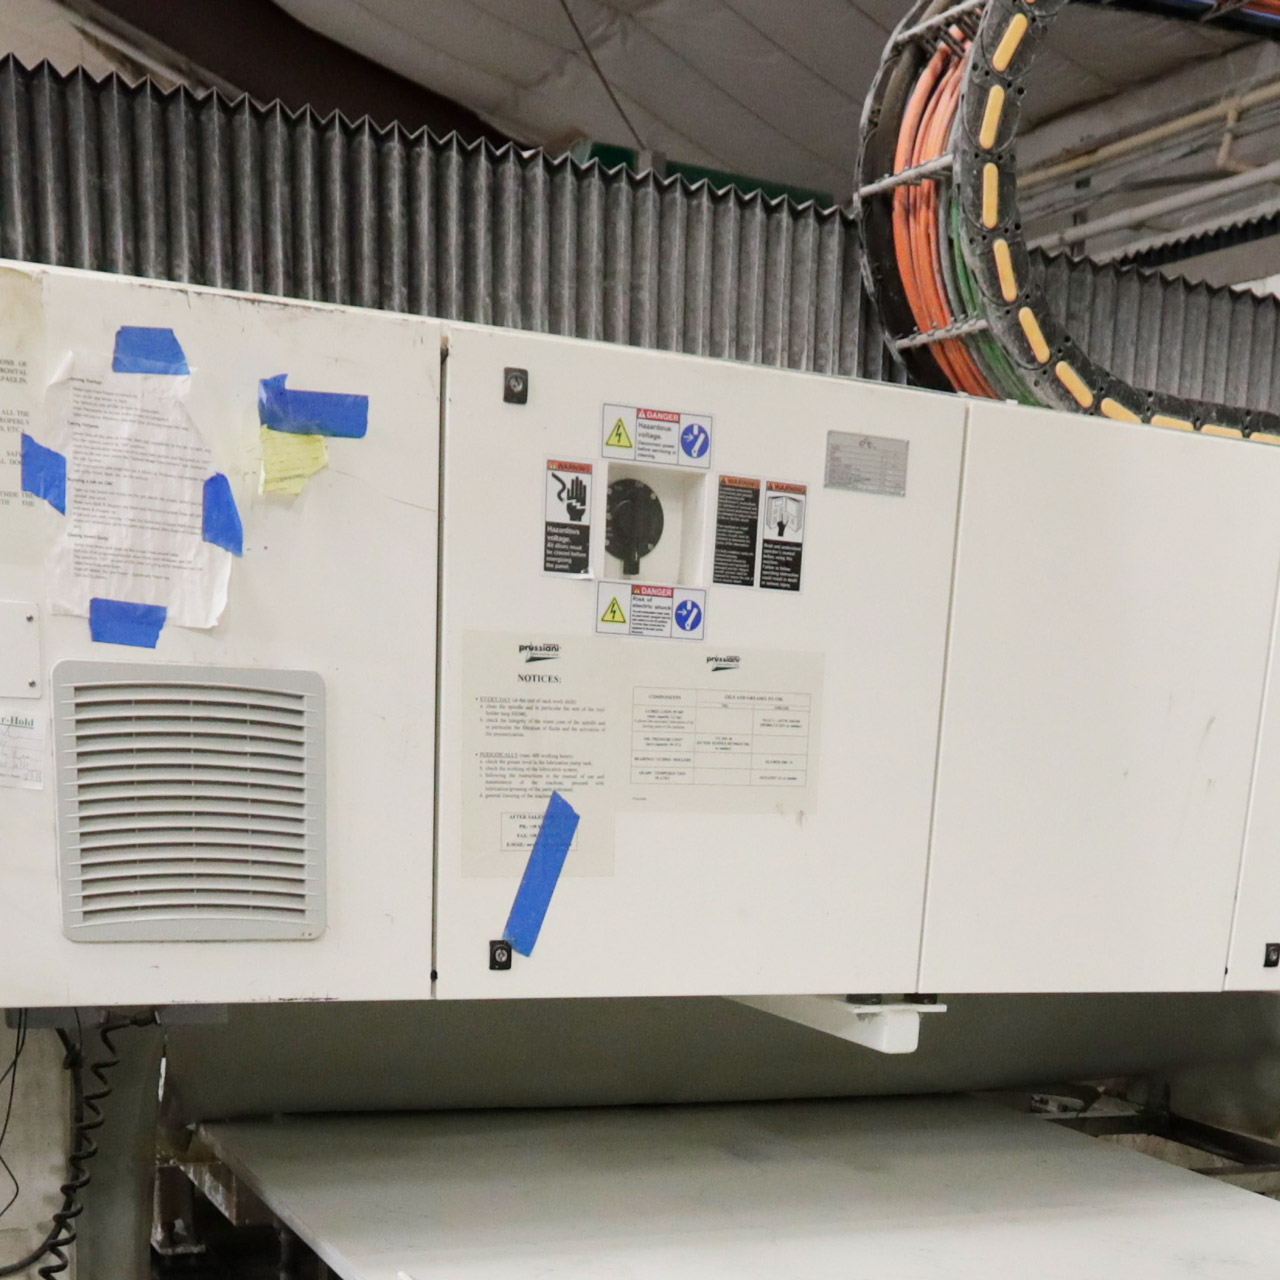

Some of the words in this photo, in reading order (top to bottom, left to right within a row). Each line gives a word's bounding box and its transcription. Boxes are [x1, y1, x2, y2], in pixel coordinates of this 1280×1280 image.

[1, 408, 13, 416] ALL
[16, 409, 29, 417] THE
[647, 410, 679, 420] DANGER
[639, 423, 671, 431] Hazardous
[21, 499, 35, 507] THE
[547, 526, 580, 535] Hazardous
[641, 587, 672, 596] DANGER
[519, 644, 559, 653] prussiani
[517, 674, 562, 683] NOTICES:
